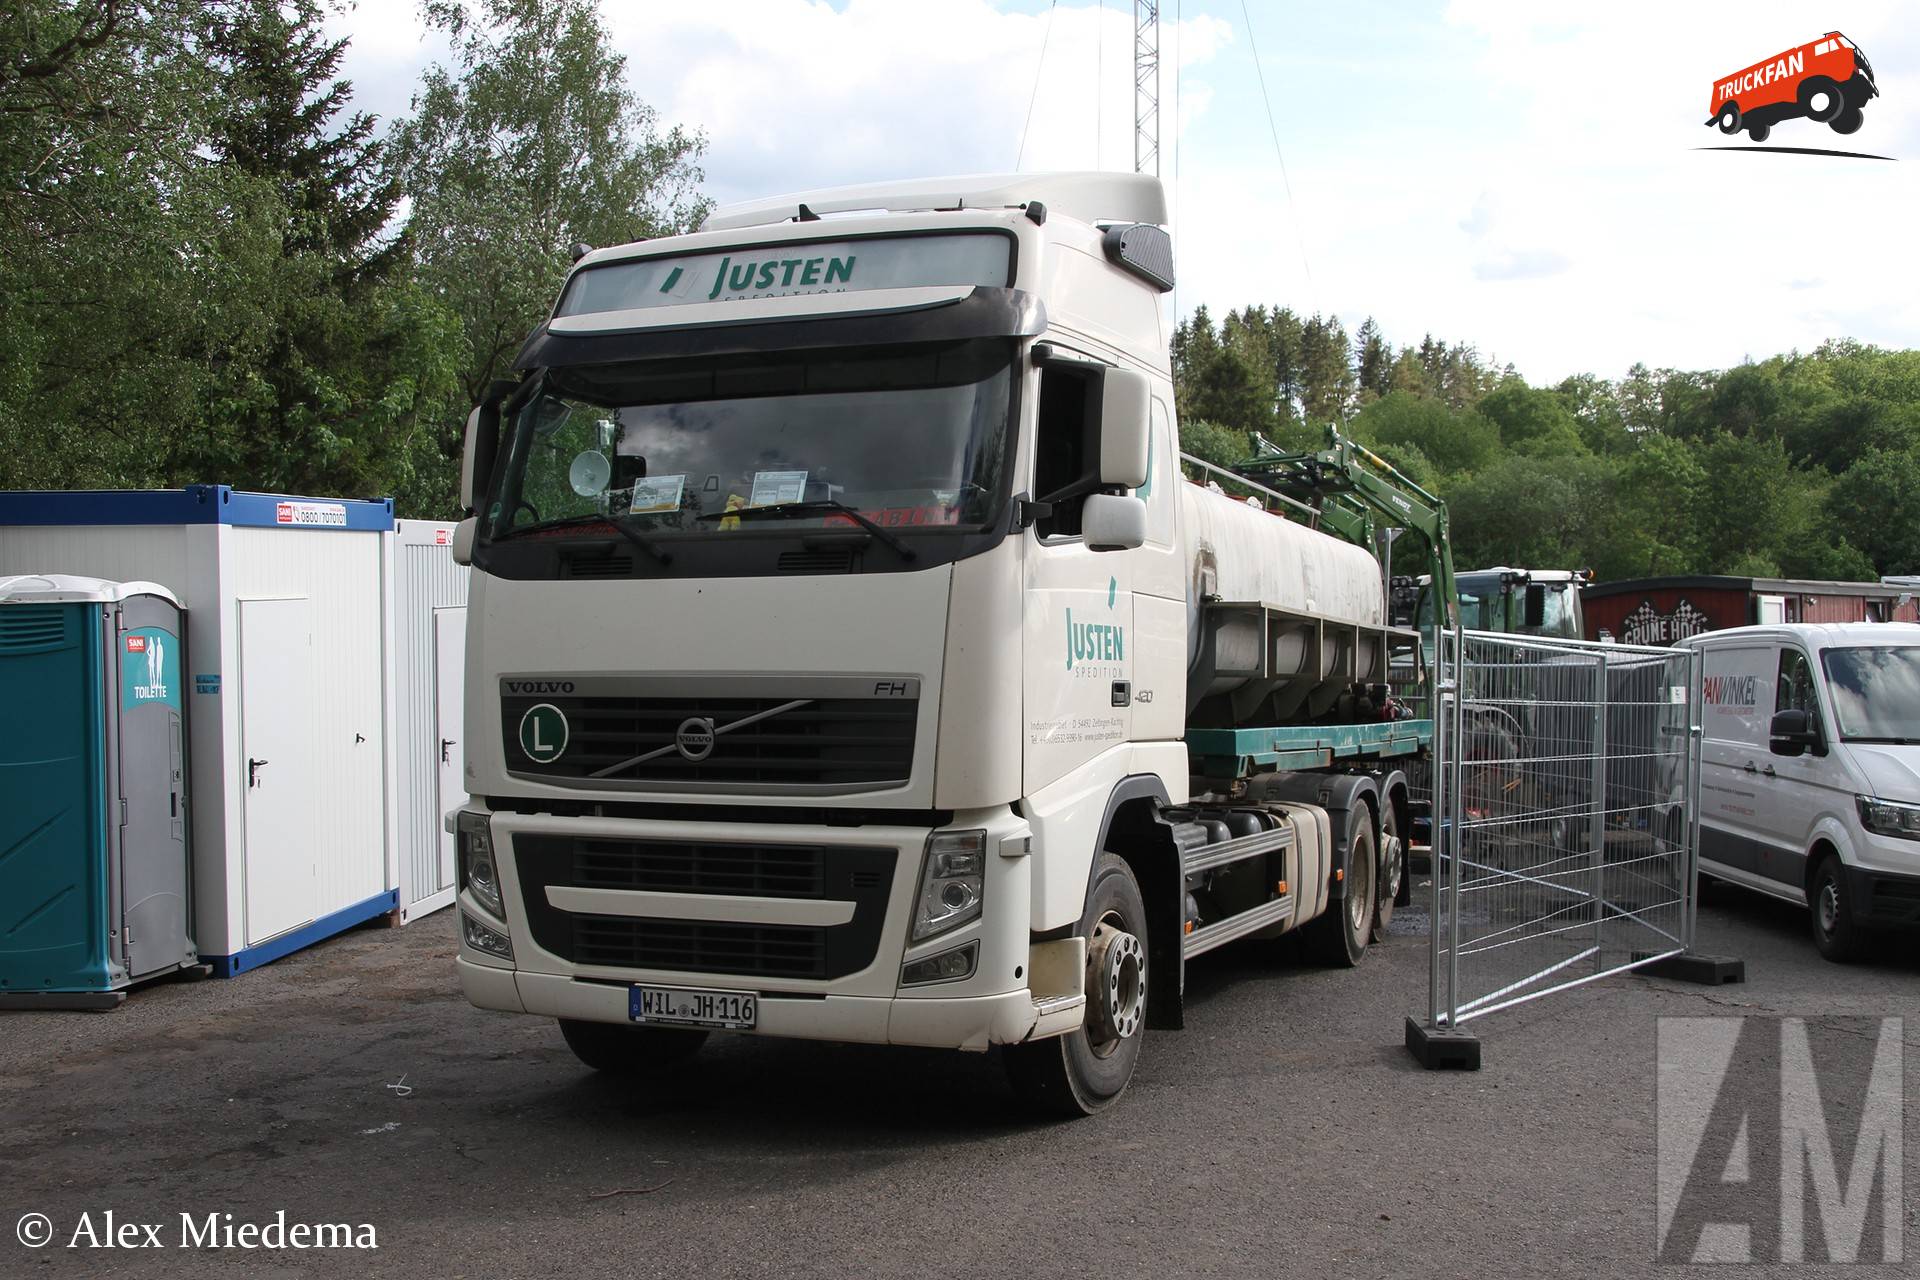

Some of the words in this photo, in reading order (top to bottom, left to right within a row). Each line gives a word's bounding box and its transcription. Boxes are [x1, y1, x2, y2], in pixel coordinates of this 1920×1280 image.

[709, 256, 856, 300] JUSTEN
[301, 511, 318, 523] 0800
[322, 512, 346, 525] 7070101
[1066, 607, 1123, 671] JUSTEN
[1624, 619, 1668, 646] GRÜNE
[128, 638, 144, 647] SANI
[1075, 666, 1123, 679] SPEDITION
[134, 685, 167, 699] TOILETTE
[506, 681, 575, 694] VOLVO
[873, 682, 906, 696] FH
[533, 716, 554, 752] L
[680, 735, 712, 743] VOLVO
[642, 991, 676, 1016] WIL
[691, 995, 714, 1018] JH
[719, 997, 753, 1020] 116
